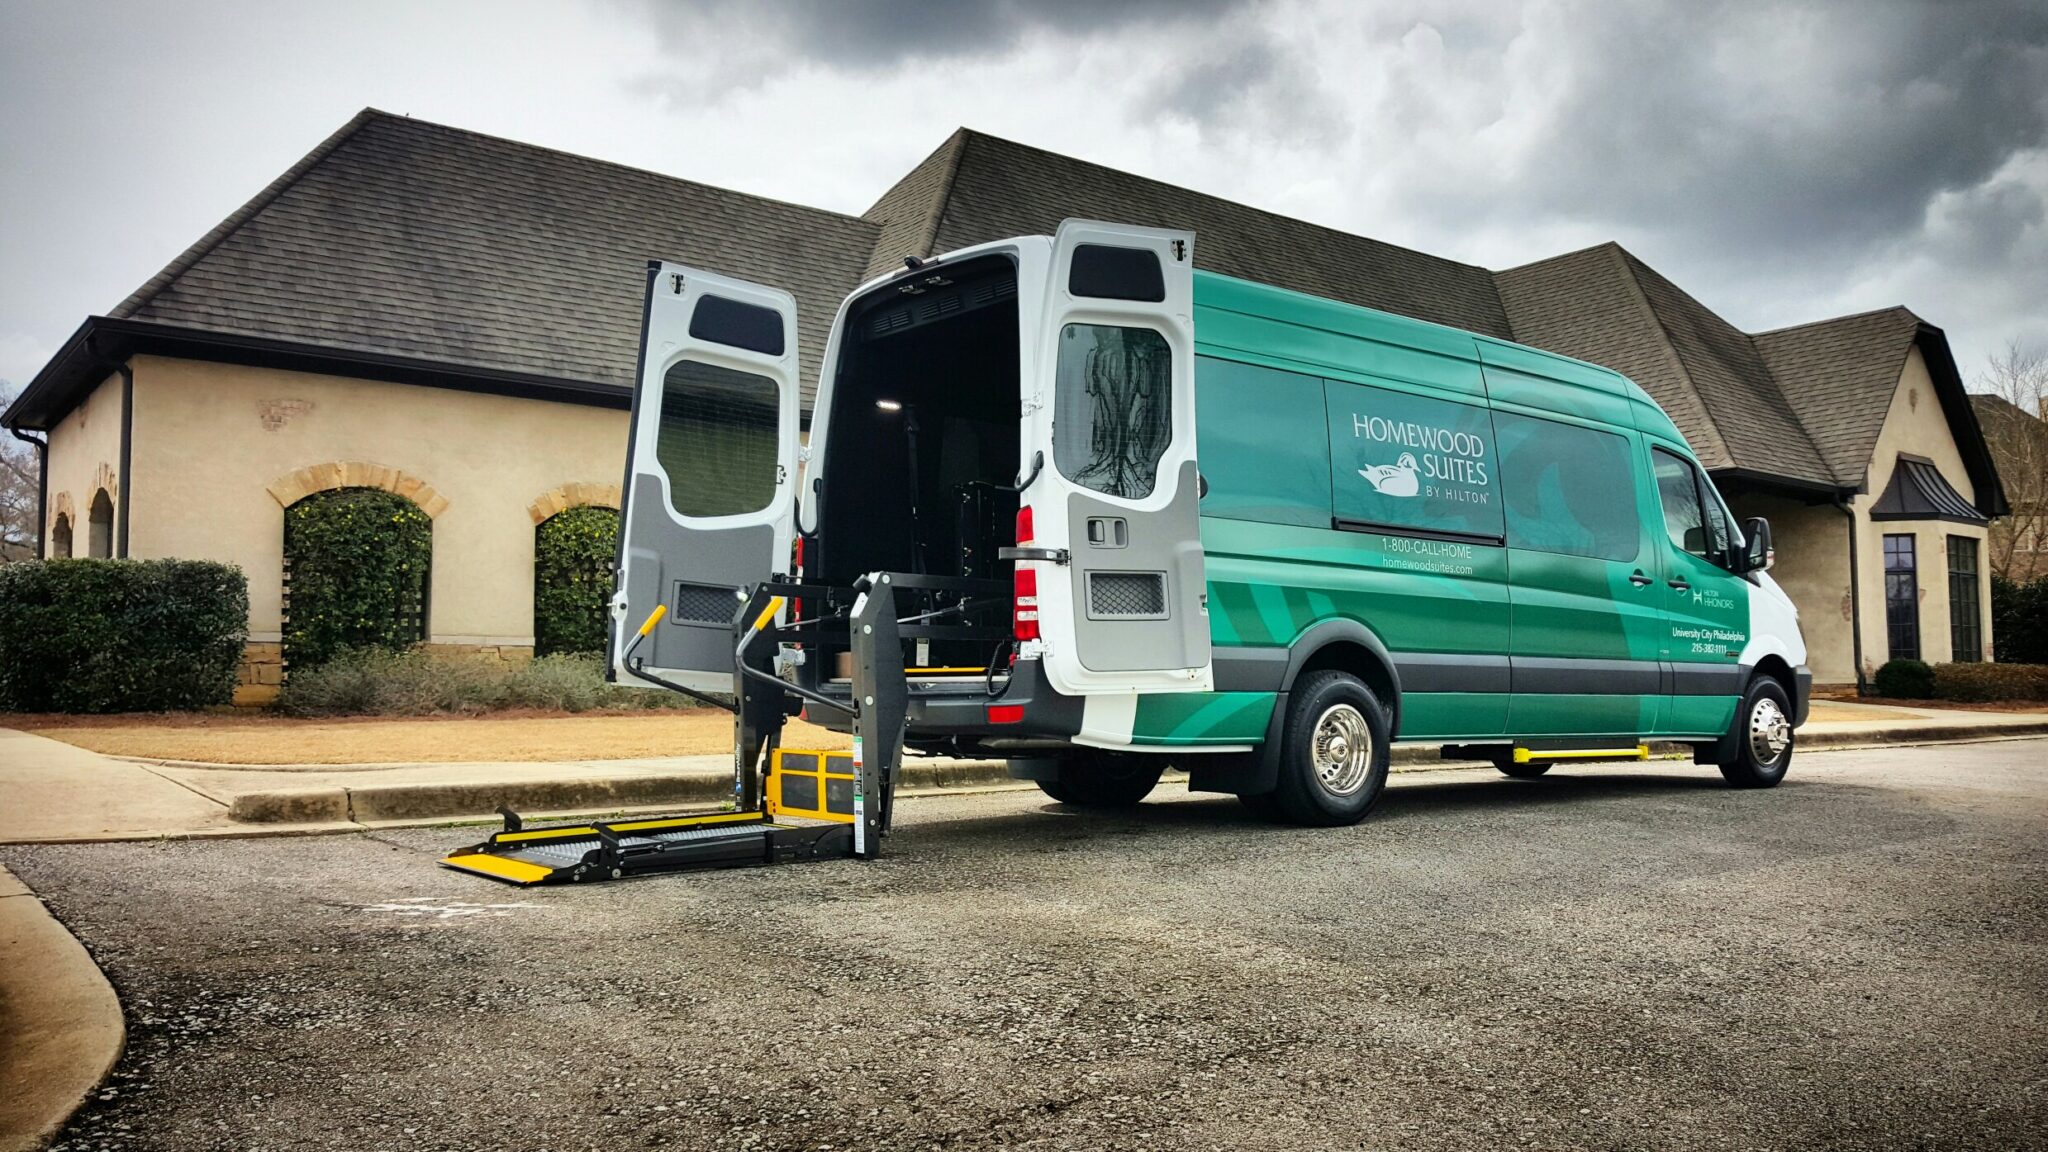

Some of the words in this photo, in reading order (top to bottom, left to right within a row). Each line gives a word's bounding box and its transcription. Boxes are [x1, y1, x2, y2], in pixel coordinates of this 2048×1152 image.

[1353, 413, 1484, 458] HOMEWOOD
[1423, 453, 1488, 486] SUITES
[1426, 485, 1440, 498] BY
[1446, 488, 1487, 504] HILTON
[1382, 537, 1472, 559] 1-800-CALL-HOME
[1382, 554, 1473, 575] homewoodsuites.com
[1703, 589, 1719, 598] HILTON
[1704, 597, 1734, 609] HHONORS
[1672, 627, 1700, 641] University
[1701, 629, 1713, 642] City
[1713, 630, 1745, 643] Philadelphia
[1691, 642, 1727, 654] 215-382-1111
